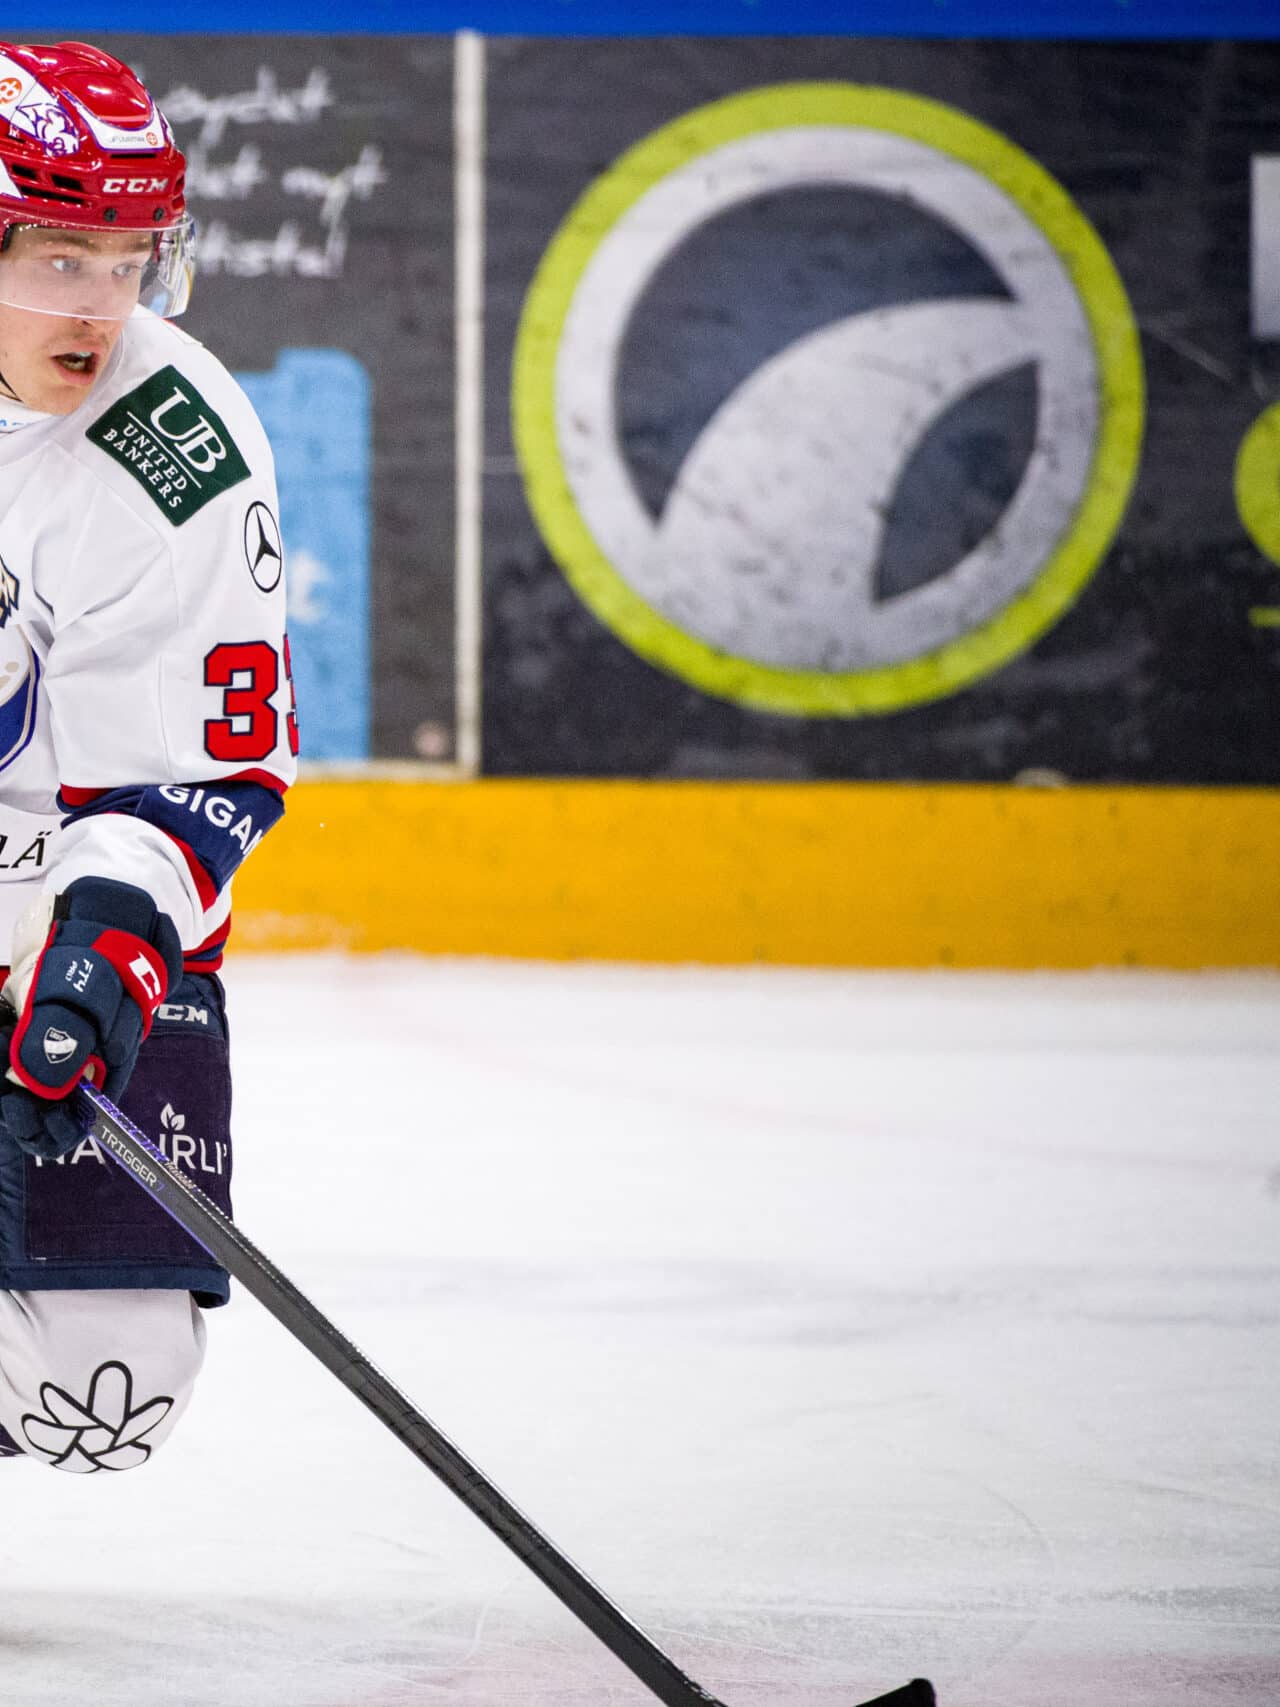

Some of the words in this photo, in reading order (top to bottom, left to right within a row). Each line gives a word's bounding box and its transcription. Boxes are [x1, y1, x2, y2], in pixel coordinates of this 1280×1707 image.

[102, 177, 169, 193] CCM
[122, 423, 188, 491] UNITED
[150, 386, 227, 473] UB
[103, 428, 182, 508] BANKERS
[204, 633, 300, 762] 3
[156, 1003, 209, 1025] CM
[101, 1125, 157, 1187] TRIGGER
